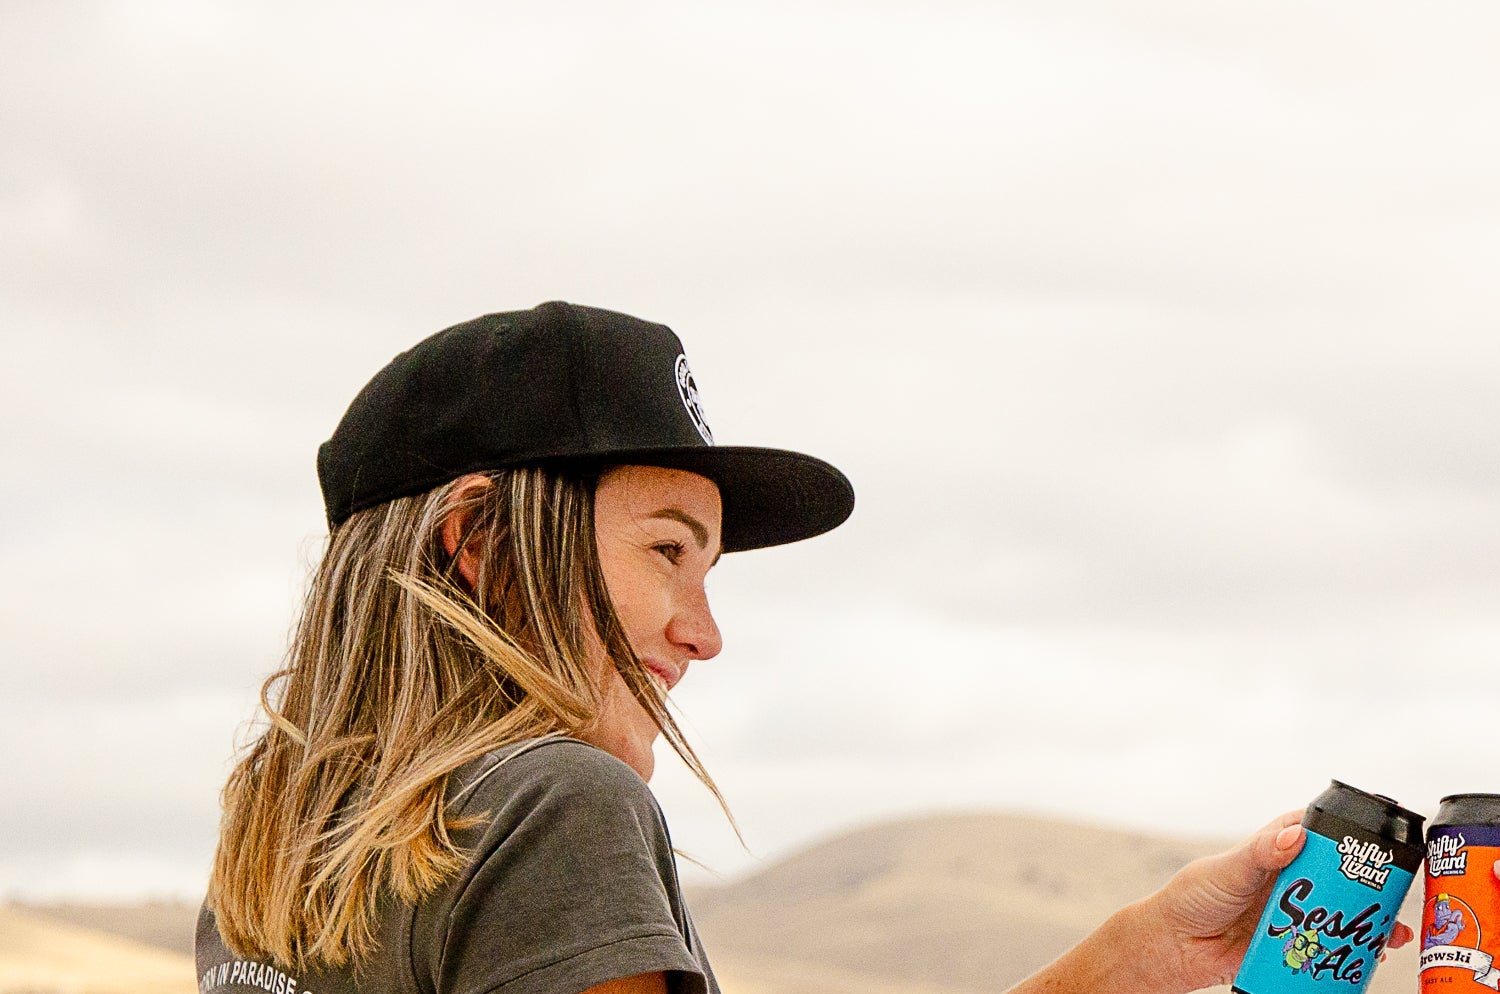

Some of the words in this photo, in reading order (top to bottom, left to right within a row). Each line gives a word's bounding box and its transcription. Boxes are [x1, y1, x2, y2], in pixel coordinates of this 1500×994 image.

[1338, 835, 1394, 868] Shifty
[1427, 832, 1466, 859] Shifty
[1340, 854, 1390, 884] Lizard
[1429, 852, 1466, 877] Lizard
[217, 961, 231, 986] IN
[1312, 945, 1364, 985] Ale
